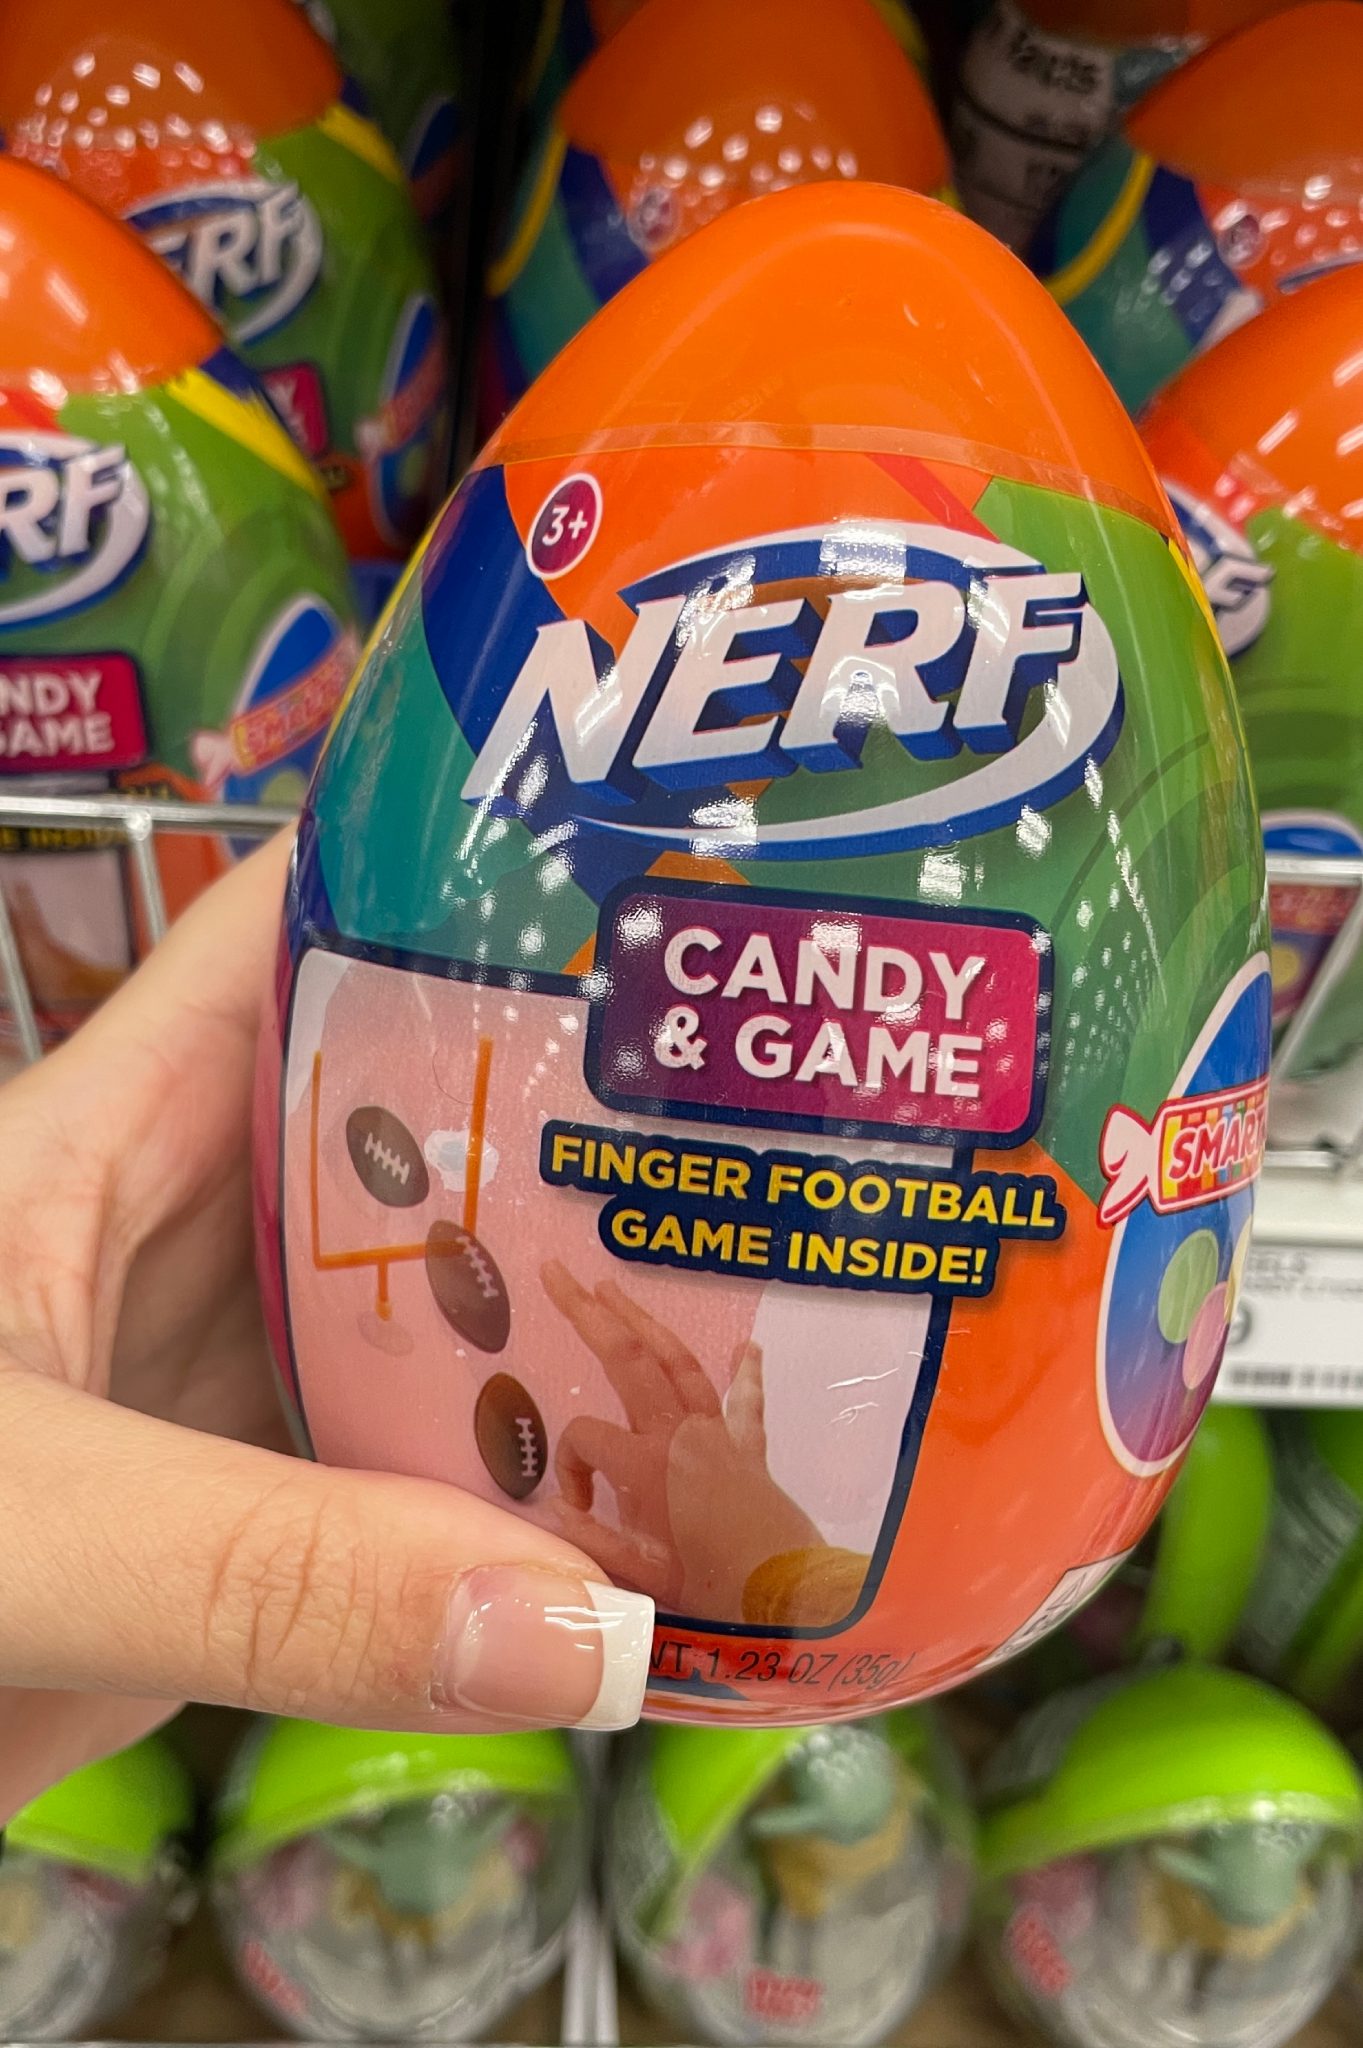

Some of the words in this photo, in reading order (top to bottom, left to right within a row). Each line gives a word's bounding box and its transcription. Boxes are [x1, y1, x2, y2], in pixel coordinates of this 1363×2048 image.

[542, 504, 588, 546] 3+
[461, 572, 1084, 804] NERF
[0, 711, 115, 757] AME
[663, 925, 986, 1020] CANDY
[653, 1005, 708, 1071] &
[734, 1014, 984, 1099] GAME
[551, 1133, 752, 1199] FINGER
[766, 1163, 1056, 1228] FOOTBALL
[610, 1208, 772, 1267] GAME
[787, 1232, 988, 1286] INSIDE!
[706, 1648, 782, 1682] 1.23
[787, 1652, 839, 1685] OZ
[827, 1651, 916, 1692] (35g)
